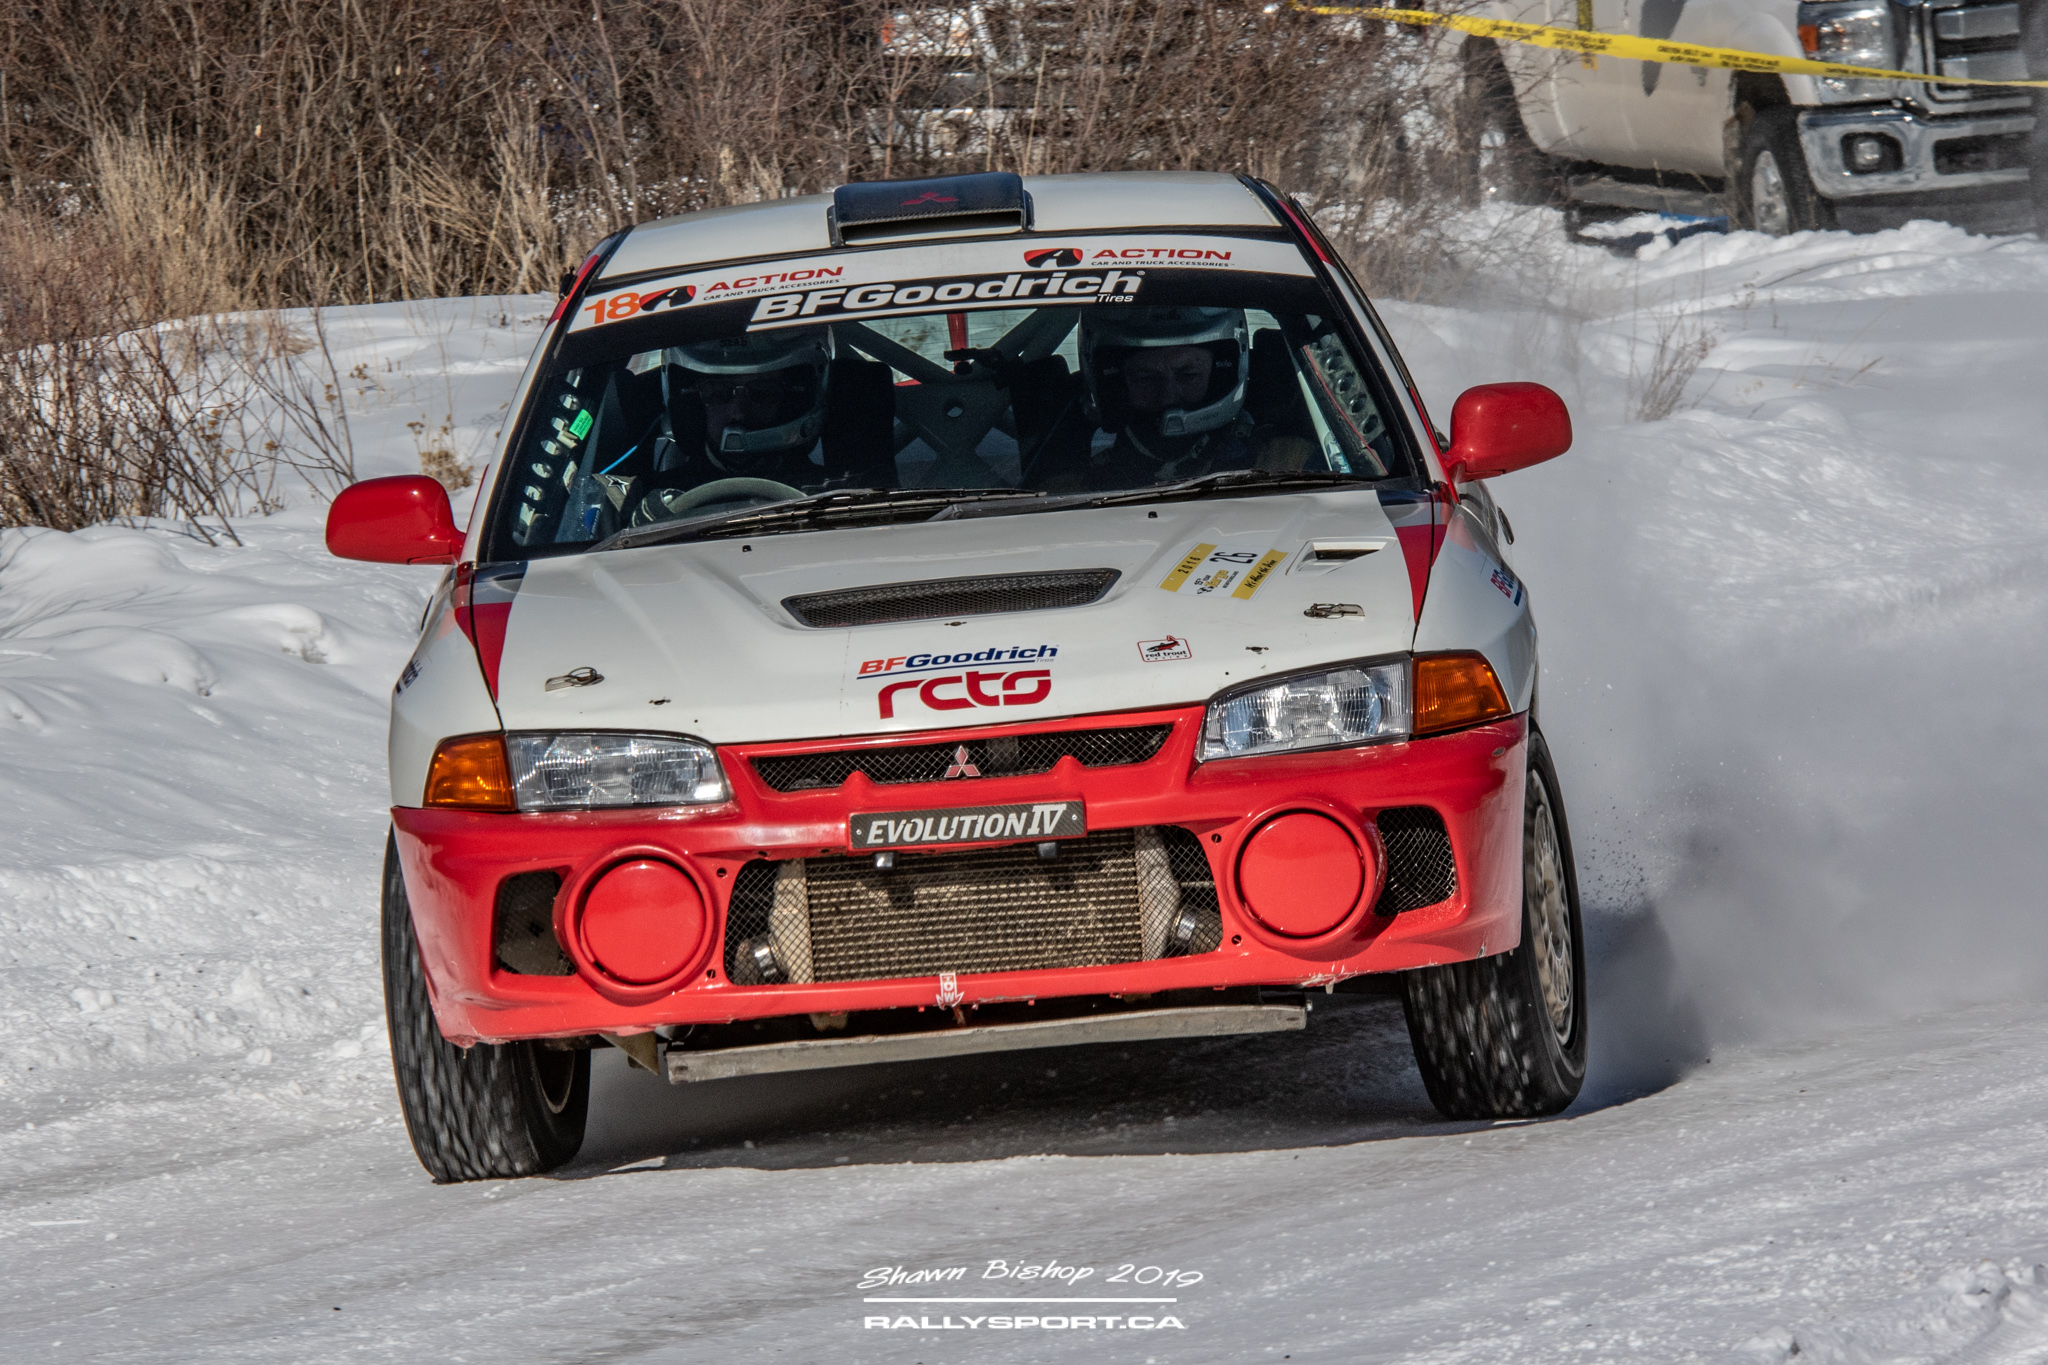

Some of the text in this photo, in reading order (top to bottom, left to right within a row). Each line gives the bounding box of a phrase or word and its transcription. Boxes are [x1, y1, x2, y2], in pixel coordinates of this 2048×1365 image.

[1092, 248, 1232, 261] ACTION
[1167, 260, 1229, 268] ACCESSORIES
[703, 278, 841, 301] CAR AND TRUCK ACCESSORIES
[704, 266, 844, 294] ACTION
[584, 291, 641, 325] 18
[750, 270, 1143, 323] BFGoodrich
[1097, 293, 1134, 303] Tires
[1178, 556, 1202, 575] 2016
[1209, 551, 1259, 565] 26
[858, 644, 1059, 675] BFGoodrich
[866, 803, 1067, 845] EVOLUTION IV
[943, 975, 954, 1002] TOW
